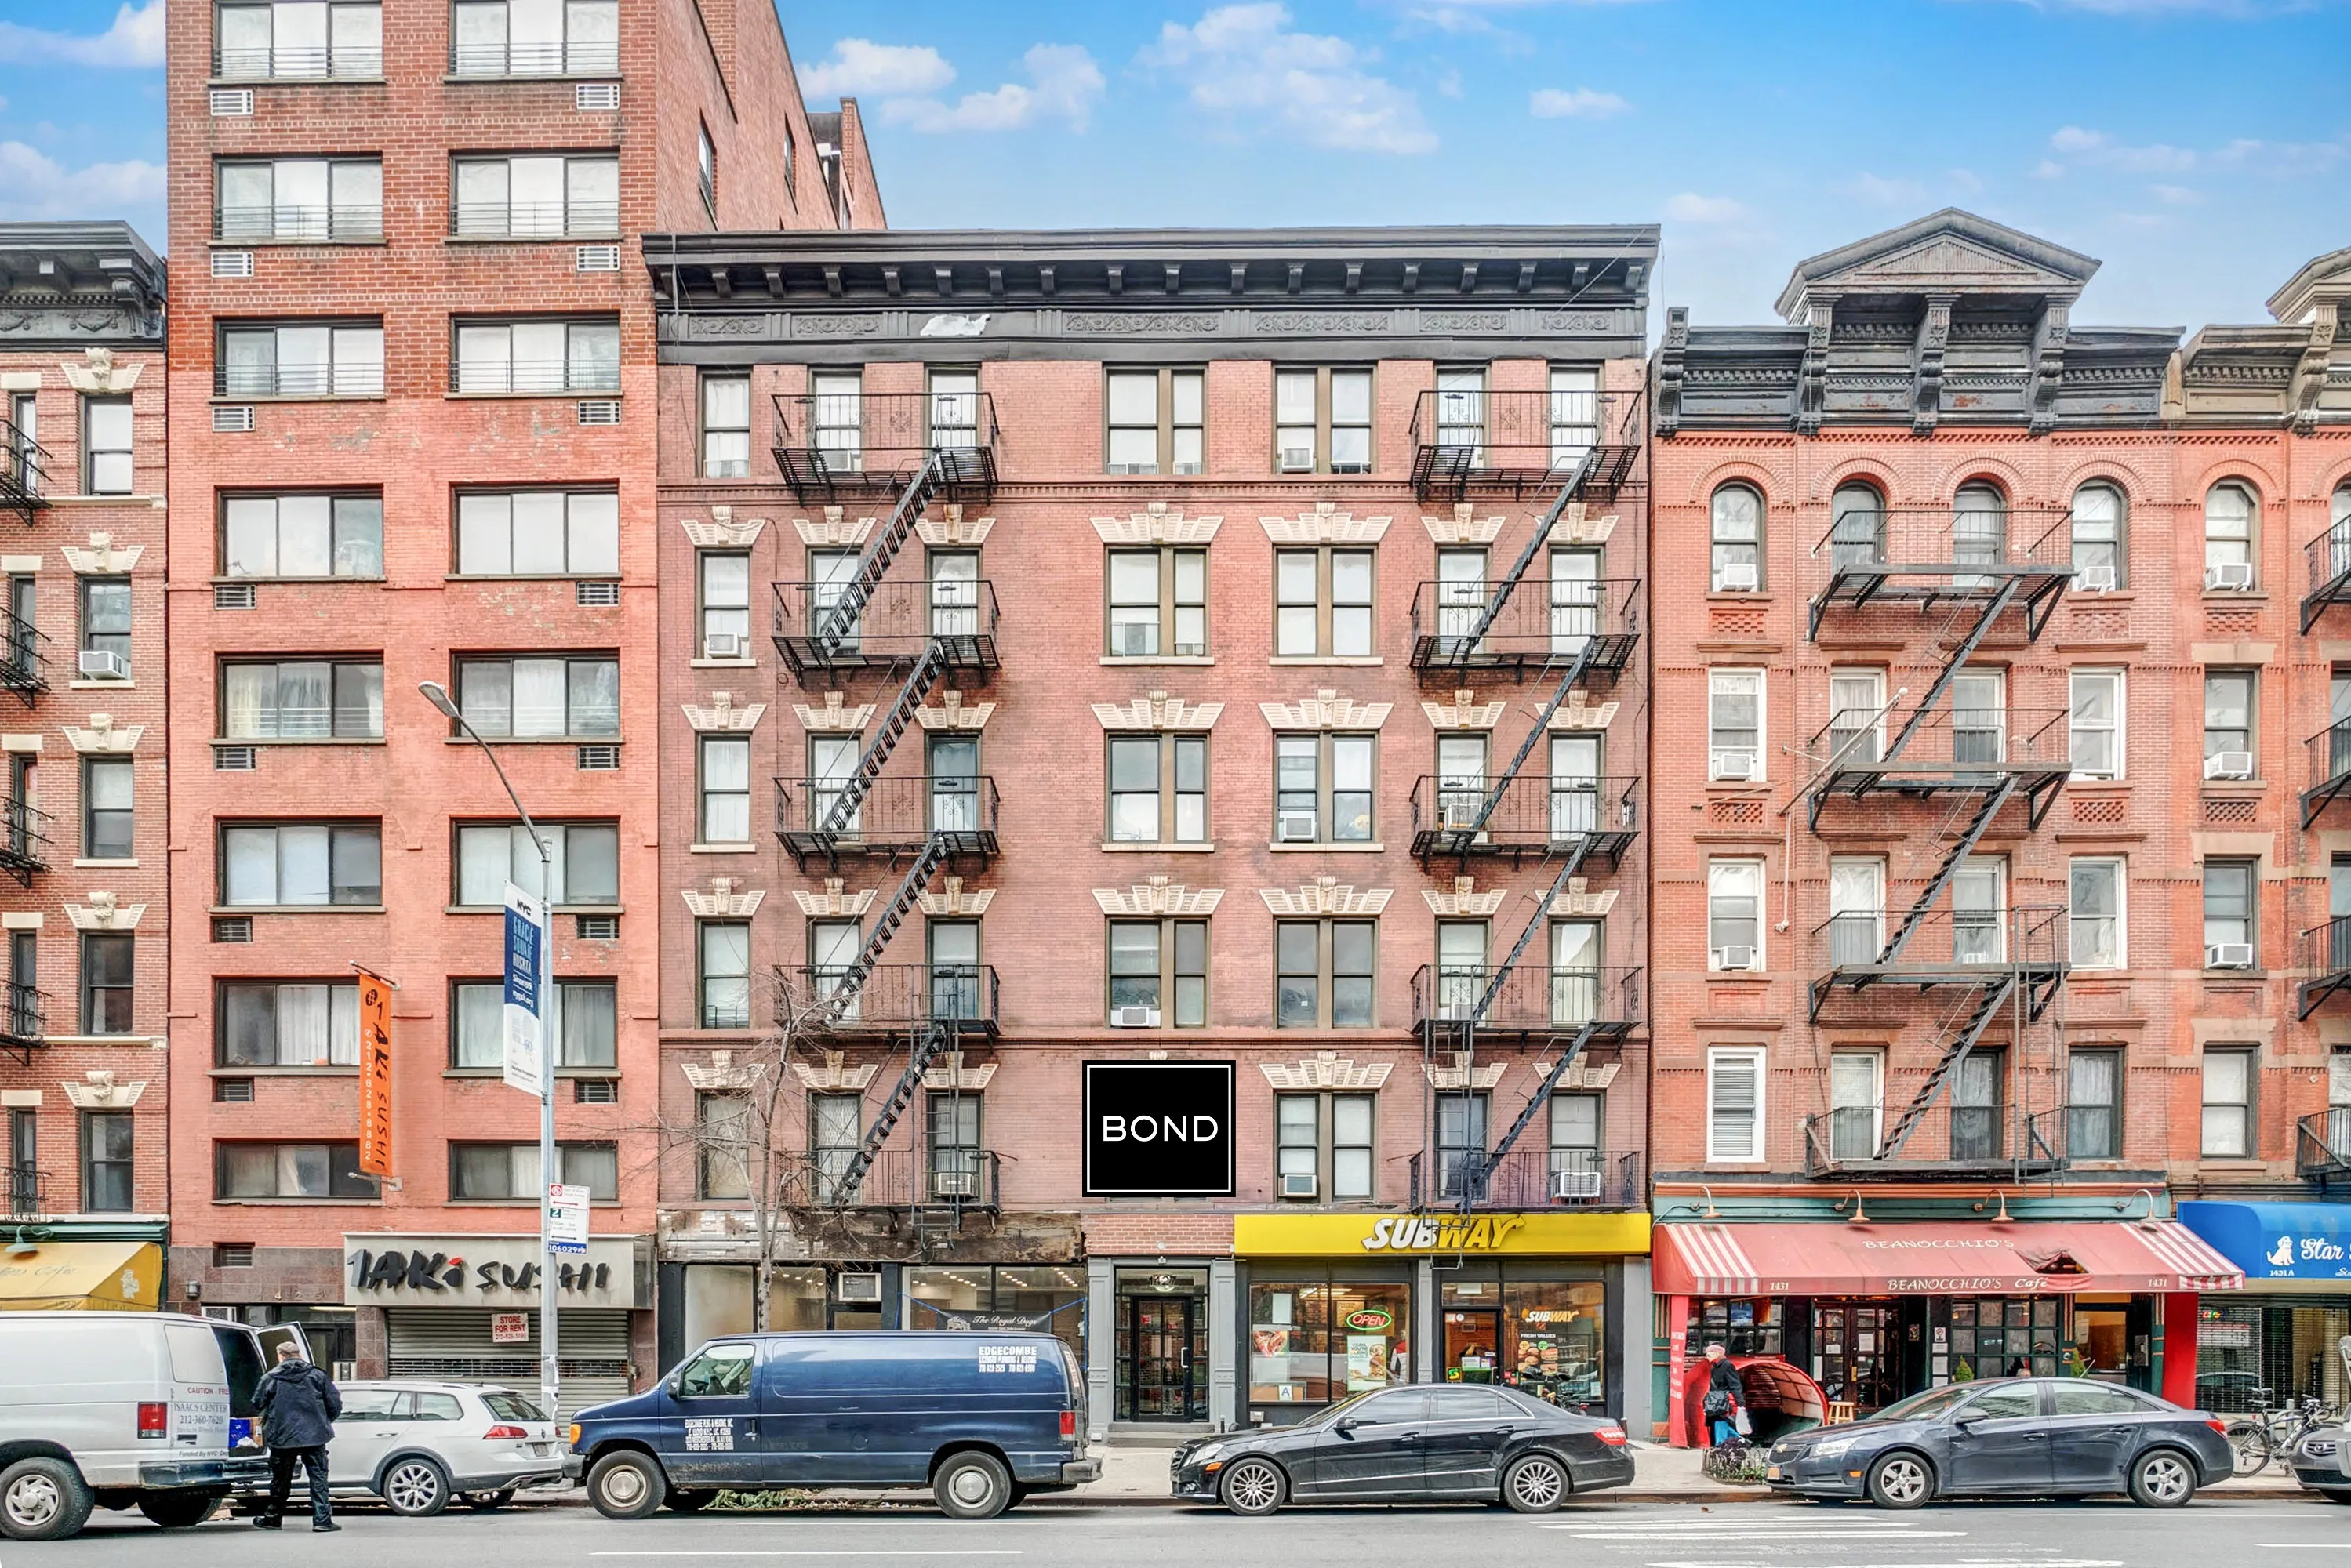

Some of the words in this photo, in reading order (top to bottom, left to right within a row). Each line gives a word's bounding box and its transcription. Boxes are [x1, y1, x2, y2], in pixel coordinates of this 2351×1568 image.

[516, 899, 532, 916] NYC
[376, 1091, 388, 1167] SUSHI
[551, 1208, 560, 1218] 2
[1361, 1217, 1526, 1250] SUBWAY
[1862, 1239, 2015, 1249] BEANOCCHIO'S
[2300, 1238, 2344, 1260] Star
[1770, 1282, 1789, 1290] 1431
[1887, 1277, 2002, 1291] BEANOCCHIO'S
[2014, 1276, 2048, 1293] Café
[2148, 1278, 2168, 1287] 1431
[972, 1316, 990, 1324] The
[990, 1316, 1016, 1327] Royal
[1016, 1316, 1037, 1327] Dogs
[1352, 1314, 1386, 1327] OPEN
[1525, 1310, 1579, 1323] SUBWAY
[979, 1346, 1037, 1356] EDGECOMBE
[1281, 1387, 1290, 1396] A
[173, 1403, 199, 1412] ISAACS
[199, 1403, 229, 1413] CENTER
